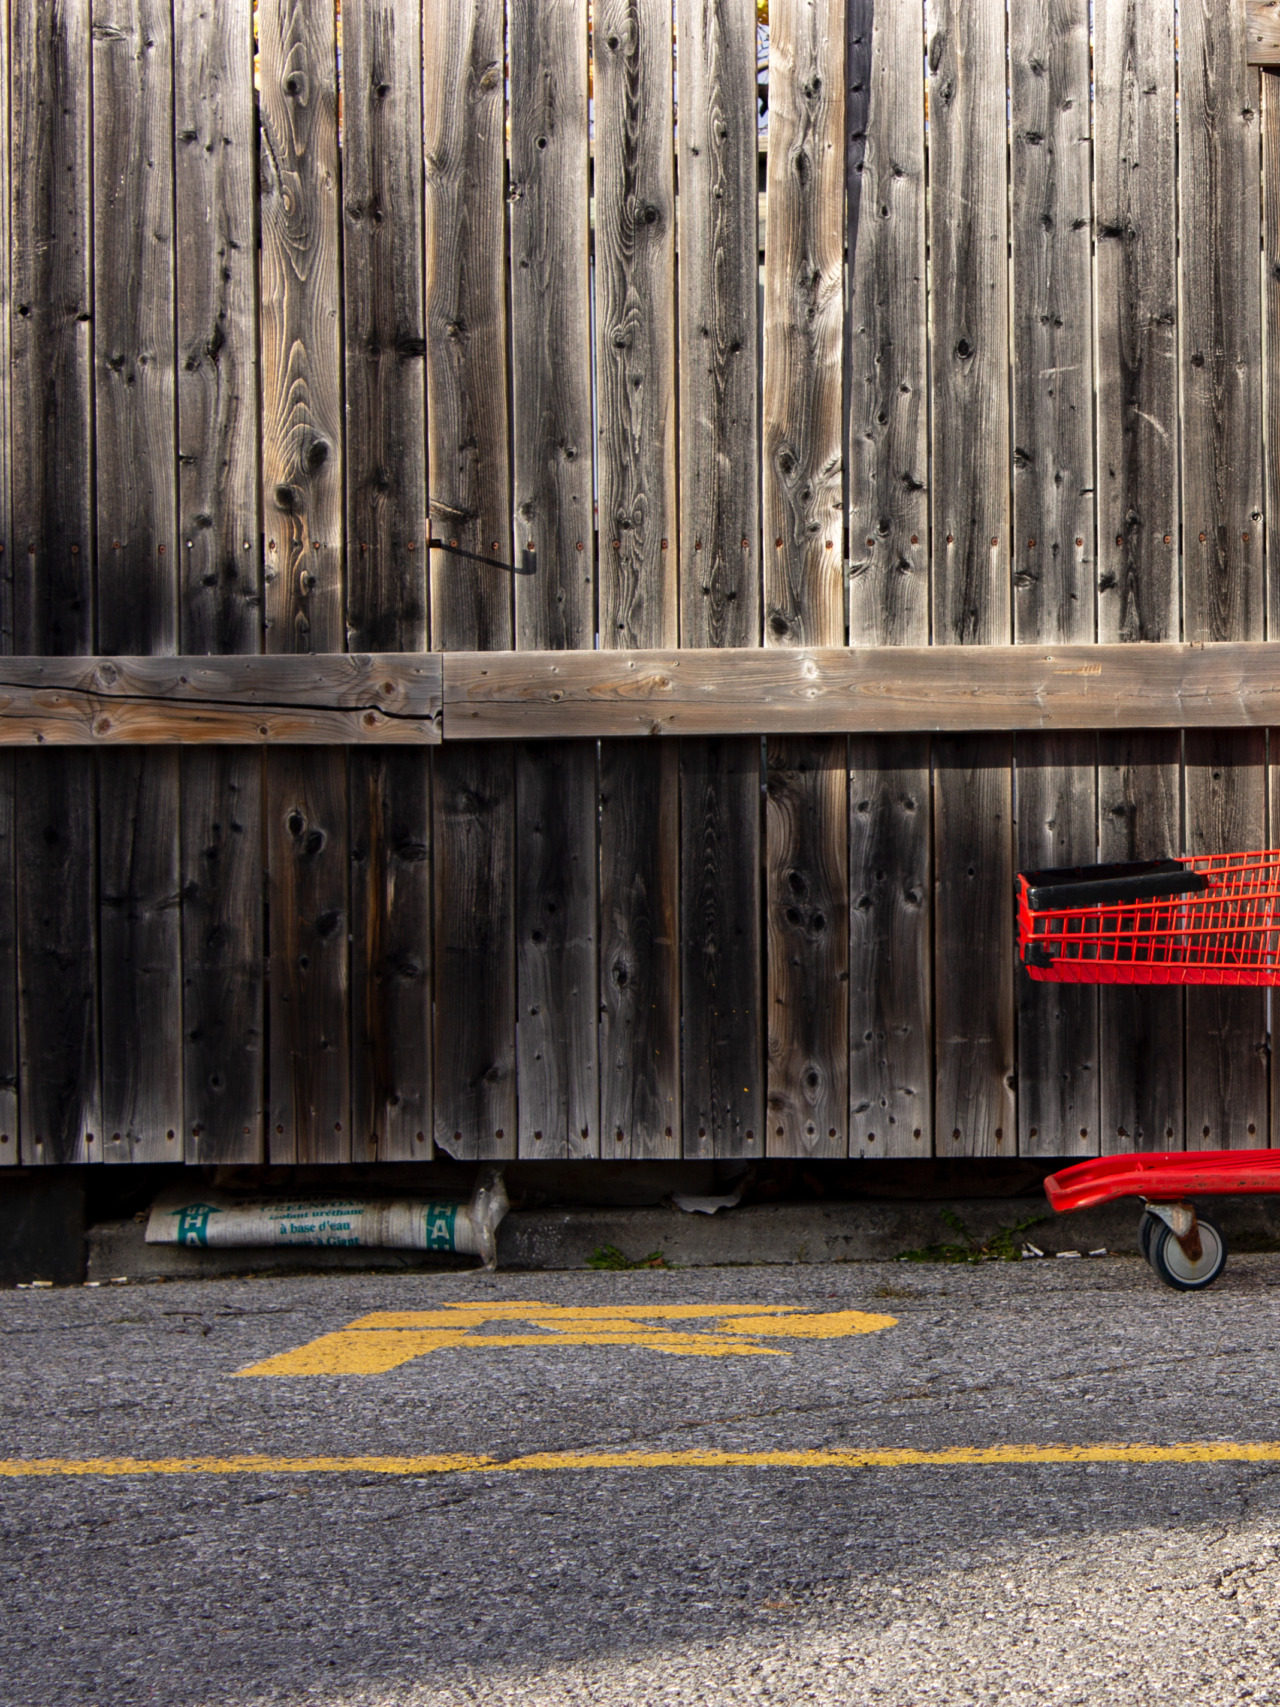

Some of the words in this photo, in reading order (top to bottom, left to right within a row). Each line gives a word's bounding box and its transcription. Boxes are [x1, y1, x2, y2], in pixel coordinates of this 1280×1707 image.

[280, 1223, 287, 1234] à
[290, 1222, 317, 1233] base
[318, 1220, 350, 1231] d'eau
